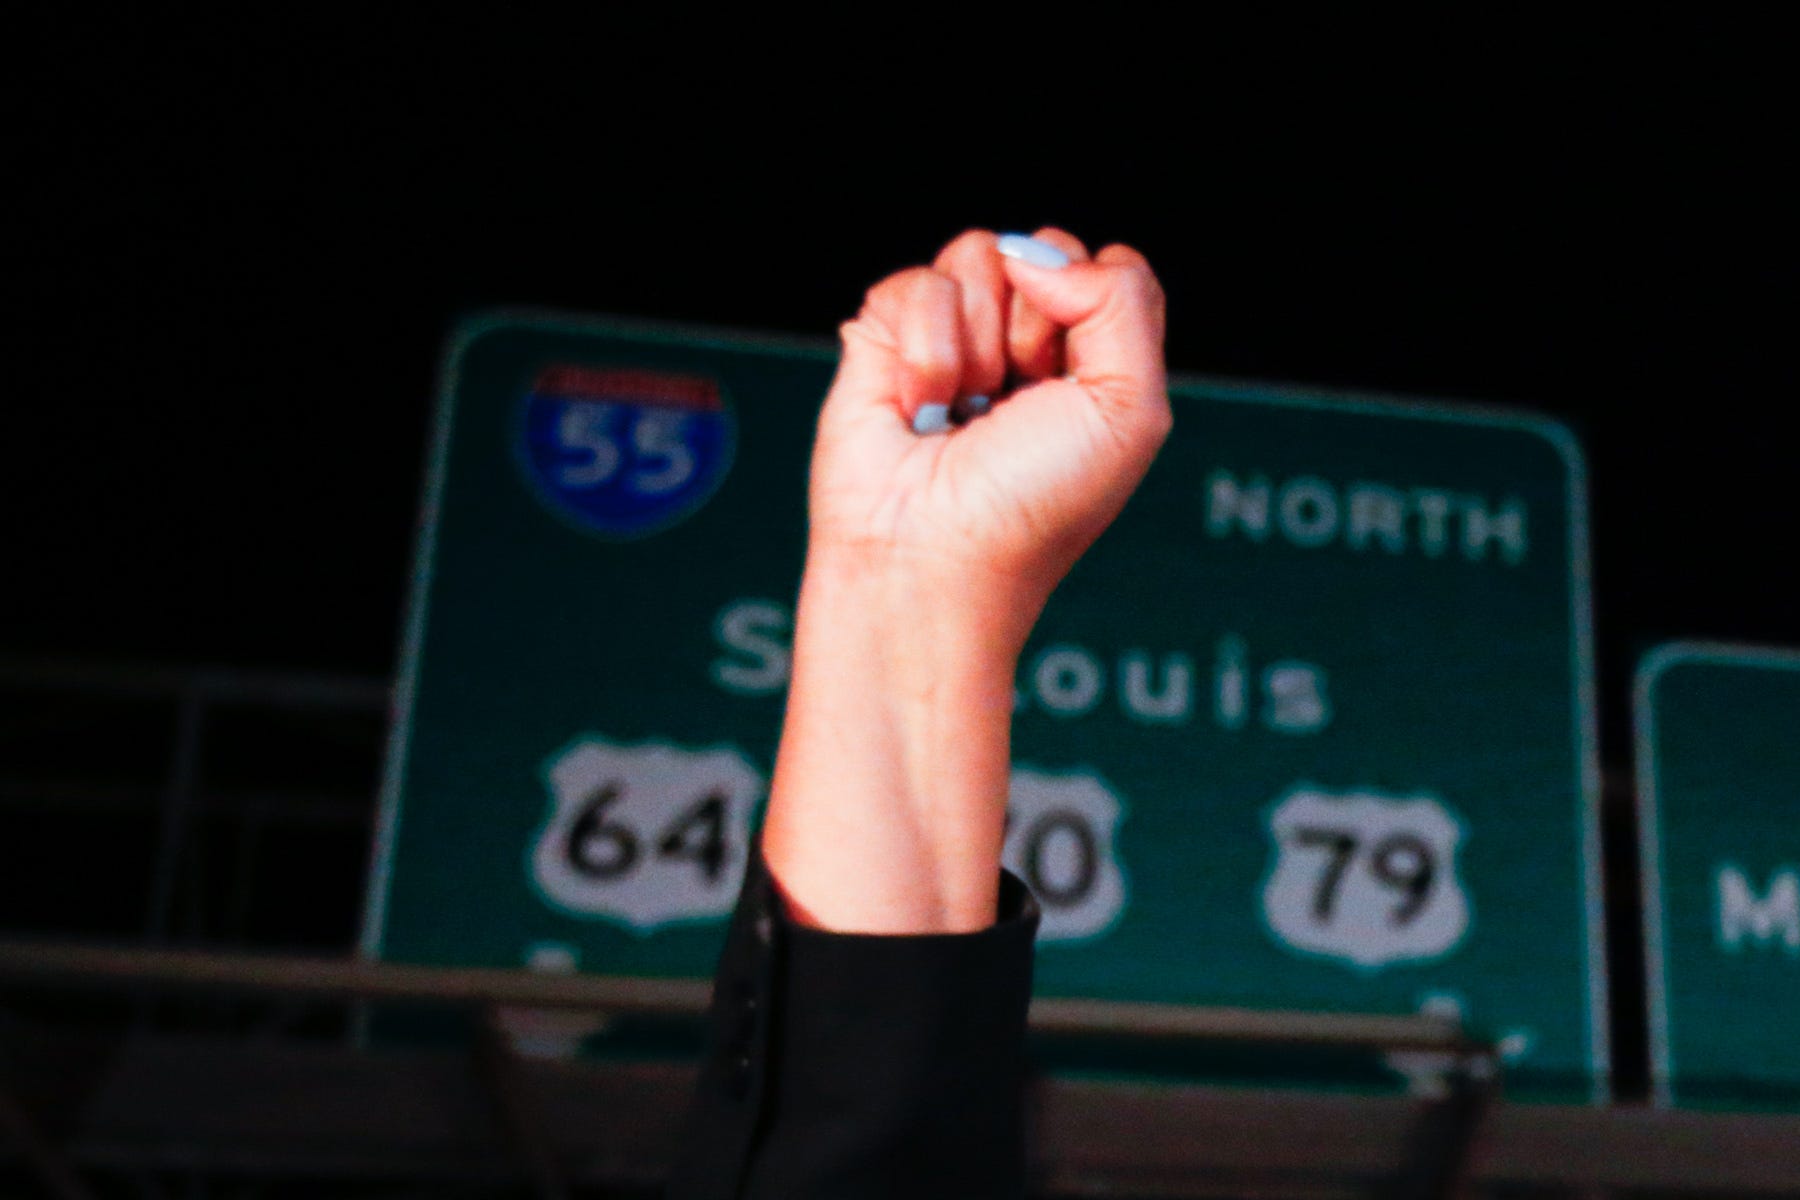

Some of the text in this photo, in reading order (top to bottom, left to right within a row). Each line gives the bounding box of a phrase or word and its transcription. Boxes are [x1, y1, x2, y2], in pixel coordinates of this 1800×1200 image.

[558, 398, 696, 494] 55
[1207, 473, 1528, 560] NORTH
[716, 600, 1328, 732] S ouis
[564, 782, 730, 886] 64
[1022, 806, 1100, 910] 0
[1296, 826, 1438, 930] 79
